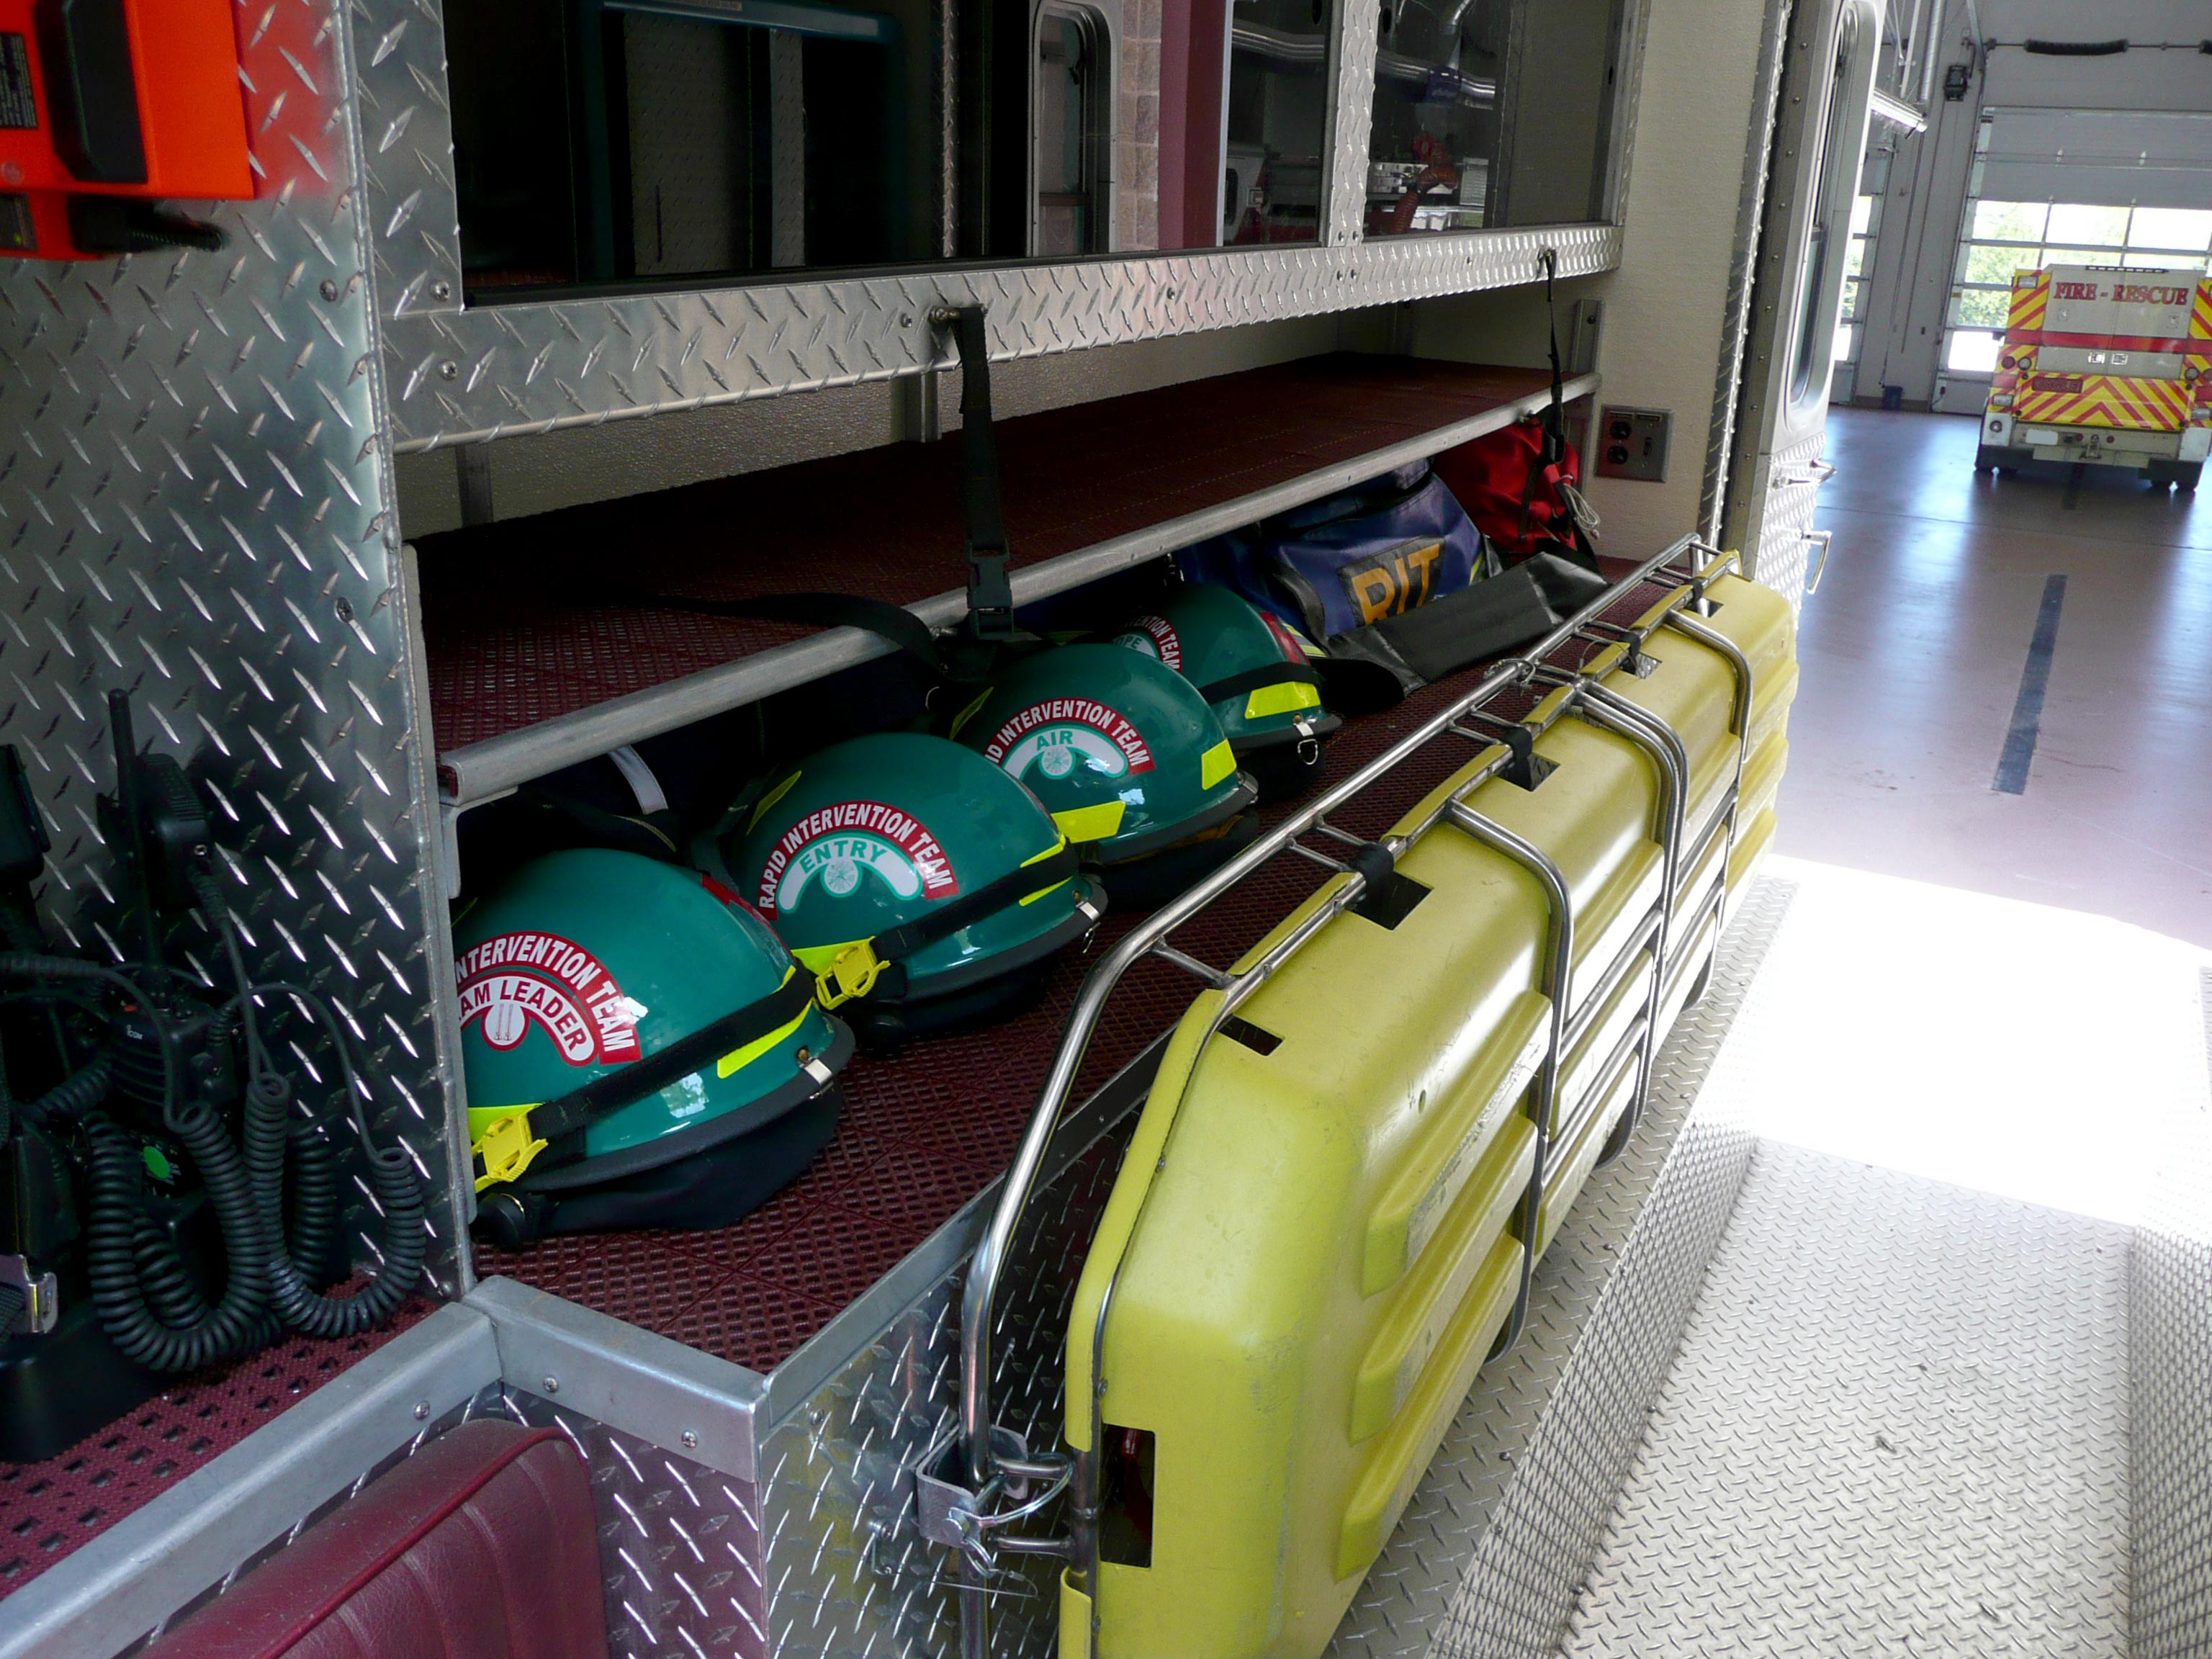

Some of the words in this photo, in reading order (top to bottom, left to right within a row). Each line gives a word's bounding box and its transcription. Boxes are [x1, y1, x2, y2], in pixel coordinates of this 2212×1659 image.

[2054, 282, 2098, 301] FIRE
[2111, 284, 2190, 306] RESCUE
[1351, 543, 1441, 625] RIT
[1115, 635, 1143, 649] OPE
[1159, 633, 1181, 670] TEAM
[997, 699, 1117, 743] INTERVENTION
[1112, 720, 1150, 767] TEAM
[1036, 729, 1074, 751] AIR
[759, 850, 787, 909] RAPID
[782, 803, 918, 855] INTERVENTION
[909, 832, 953, 889] TEAM
[799, 839, 889, 875] ENTRY
[454, 935, 602, 991] NTERVENTION
[585, 981, 636, 1053] TEAM
[459, 982, 491, 1022] AM
[499, 979, 588, 1052] LEADER
